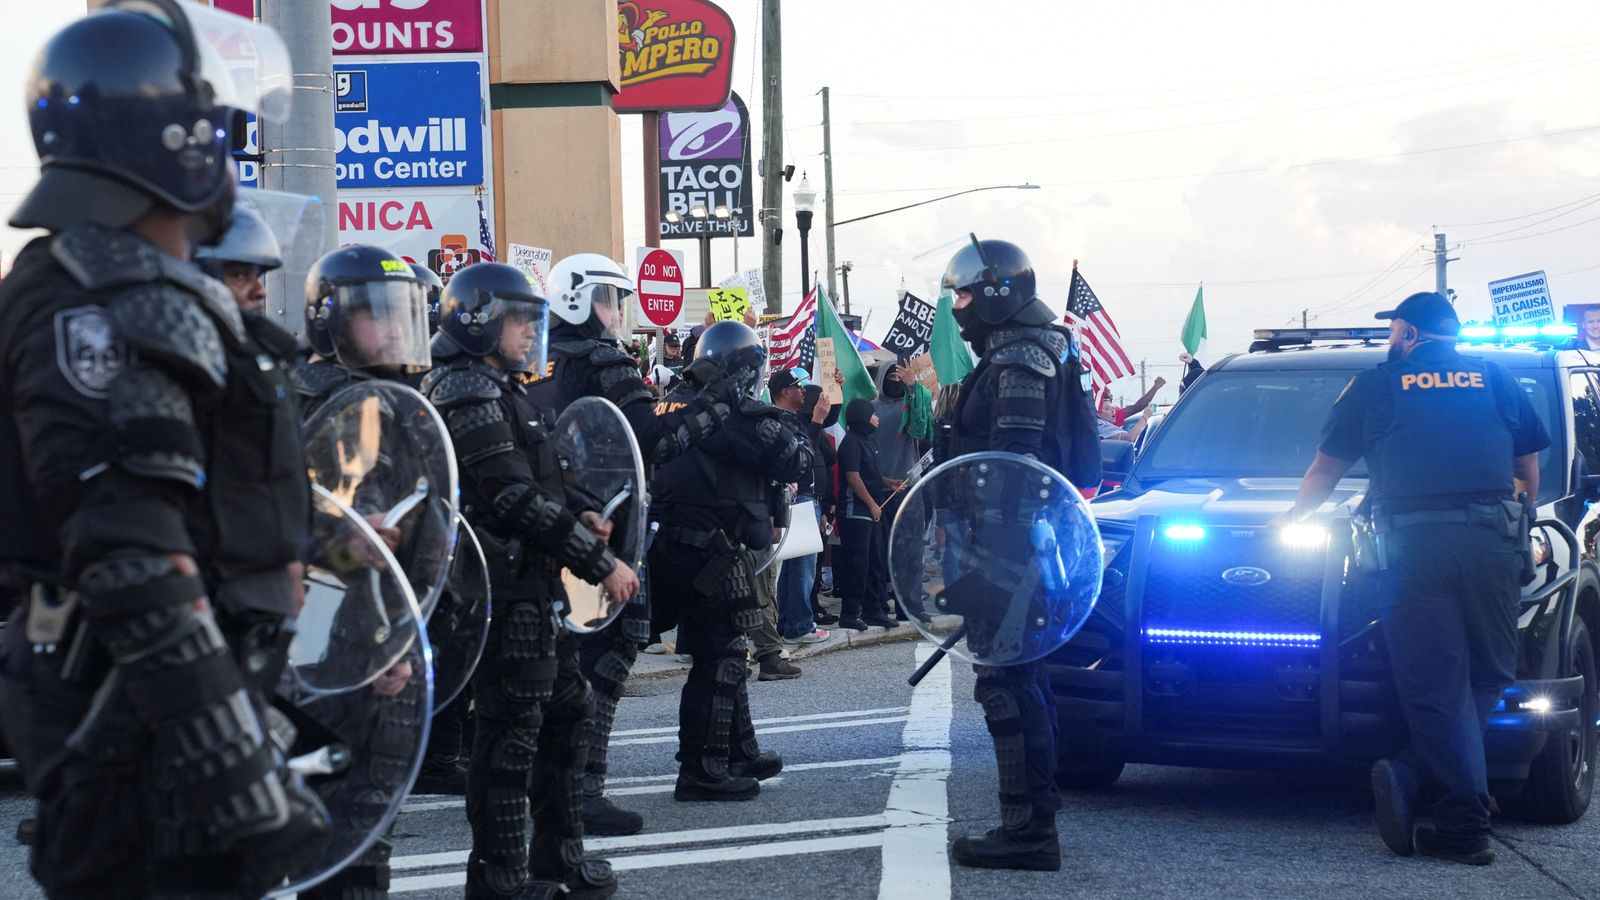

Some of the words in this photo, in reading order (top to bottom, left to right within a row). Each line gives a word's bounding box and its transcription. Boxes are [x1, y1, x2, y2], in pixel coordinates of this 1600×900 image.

[331, 21, 454, 51] OUNTS
[644, 21, 702, 44] POLLO
[622, 37, 719, 77] MPERO
[338, 102, 365, 110] goodwill
[374, 157, 467, 179] Center
[661, 164, 742, 190] TACO
[668, 191, 743, 216] BELL
[338, 201, 433, 231] NICA
[660, 221, 704, 235] DRIVE
[706, 219, 748, 232] THRU
[644, 263, 656, 276] DO
[662, 265, 677, 278] NOT
[1491, 278, 1545, 295] IMPERIALISMO
[1493, 287, 1546, 303] ESTADOUNIDENSE:
[648, 298, 674, 312] ENTER
[903, 296, 936, 326] LIBE
[1496, 303, 1511, 315] LA
[1511, 296, 1548, 312] CAUSA
[896, 312, 919, 330] AND
[1498, 315, 1510, 325] DE
[1511, 313, 1521, 323] LA
[1523, 307, 1550, 320] CRISIS
[1401, 372, 1485, 390] POLICE
